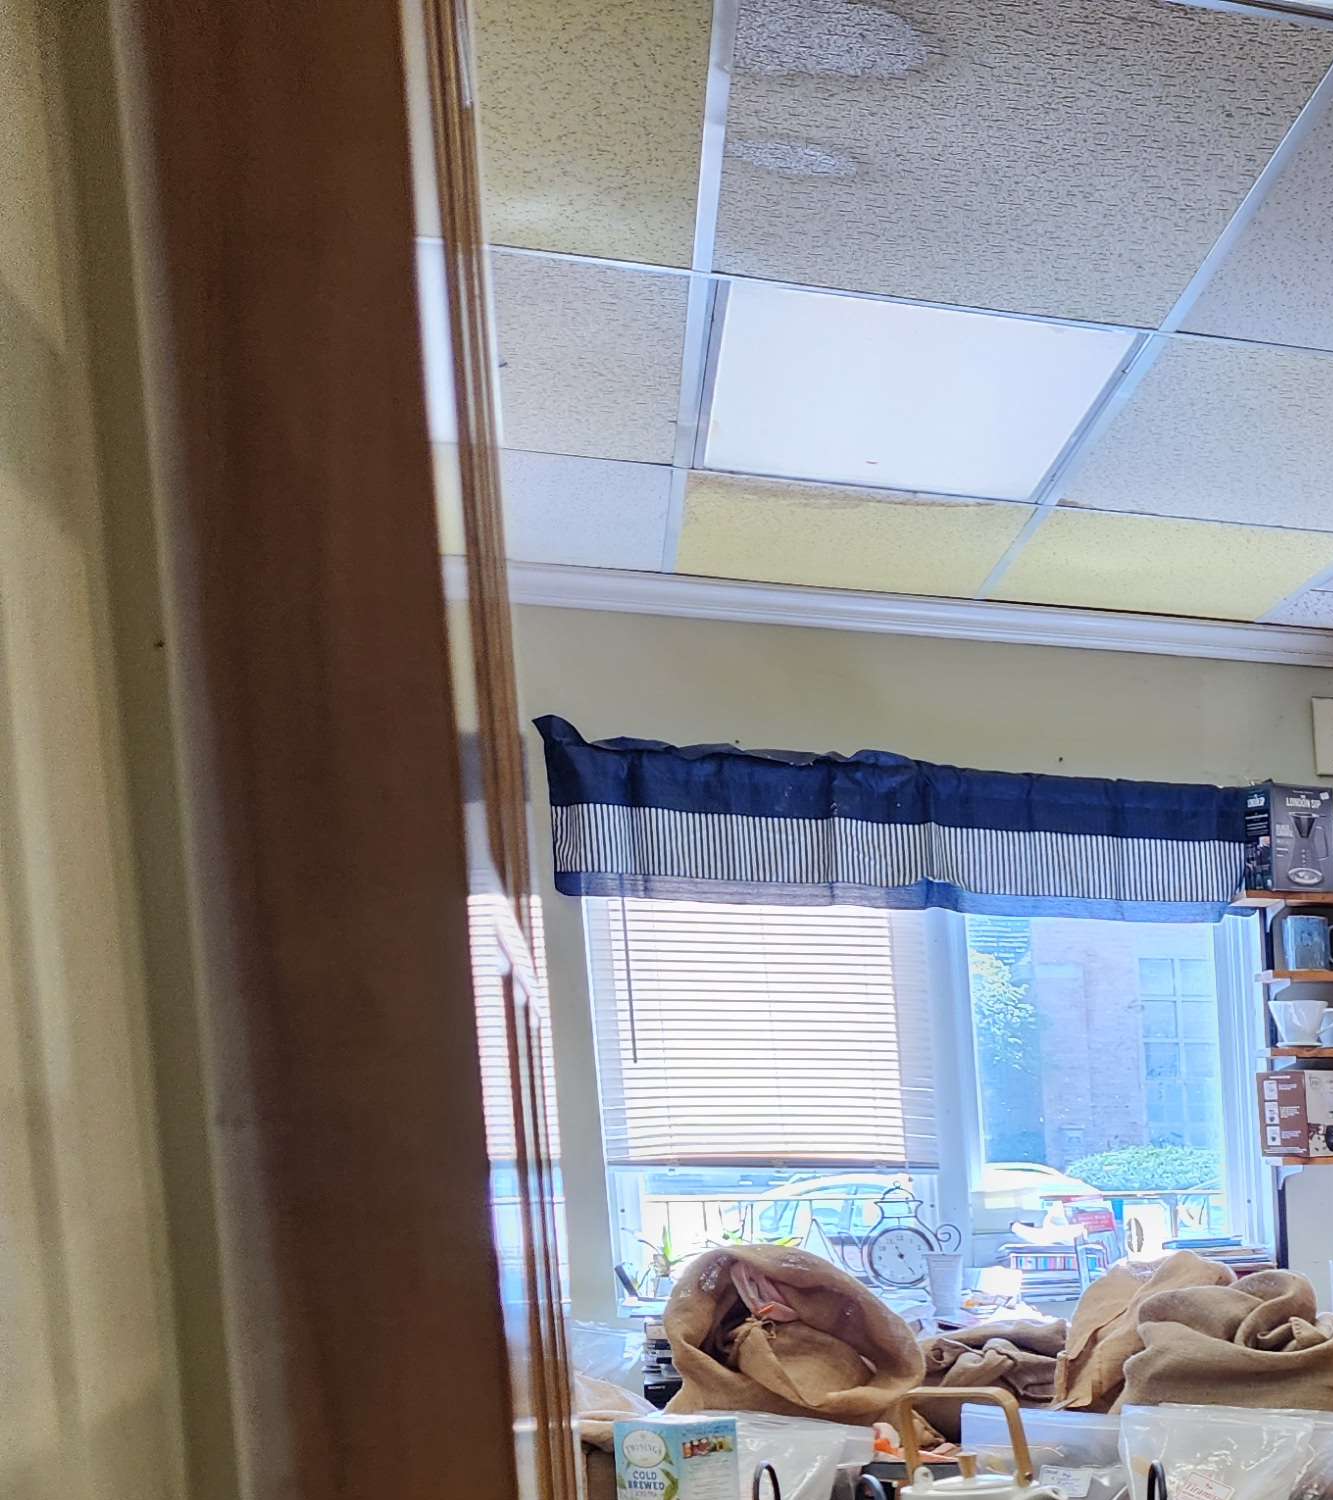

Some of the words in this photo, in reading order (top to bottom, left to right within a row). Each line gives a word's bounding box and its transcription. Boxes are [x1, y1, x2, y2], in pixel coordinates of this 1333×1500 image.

[1286, 797, 1311, 808] LONDON
[1311, 799, 1321, 809] SIP
[632, 1470, 657, 1480] COLD
[628, 1480, 665, 1491] BREWED
